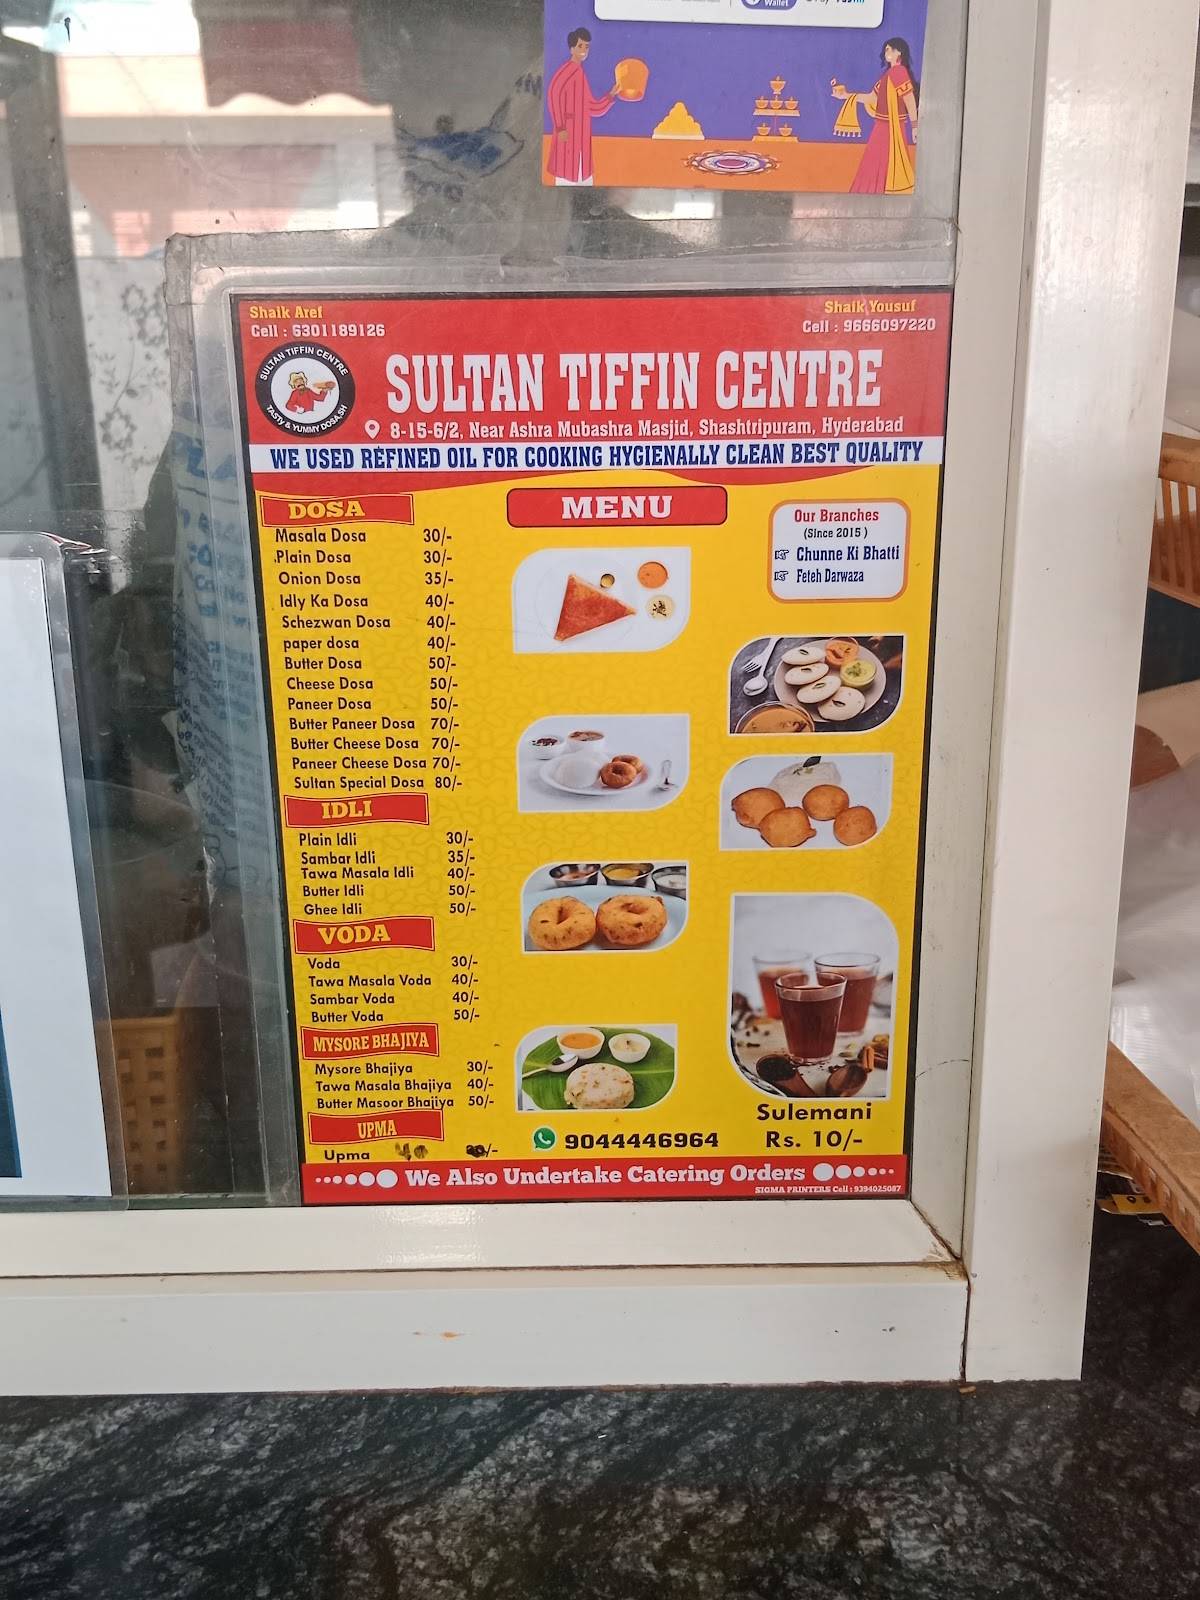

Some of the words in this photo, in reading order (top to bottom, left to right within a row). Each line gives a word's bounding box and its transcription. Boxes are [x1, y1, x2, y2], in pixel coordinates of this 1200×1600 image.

[249, 306, 291, 319] Shaik
[295, 306, 323, 319] Aref
[824, 300, 865, 314] Shaik
[869, 299, 916, 313] Yousuf
[251, 325, 278, 338] Cell
[292, 324, 385, 337] 6301189126
[802, 320, 829, 333] Cell
[843, 318, 936, 332] 9666097220
[260, 352, 286, 380] SULTAN
[285, 346, 314, 357] TIFFIN
[316, 349, 349, 376] CENTRE
[386, 353, 544, 413] SULTAN
[560, 352, 700, 411] TIFFIN
[716, 349, 883, 410] CENTRE
[292, 424, 320, 433] YUMMY
[390, 422, 464, 441] 8-15-6/2,
[469, 422, 505, 438] Near
[509, 421, 552, 438] Ashra
[558, 420, 633, 438] Mubashra
[638, 420, 694, 441] Masjid,
[699, 418, 816, 439] Shashtripuram,
[821, 416, 903, 436] Hyderabad
[271, 448, 300, 469] WE
[306, 448, 355, 469] USED
[361, 447, 441, 469] REFINED
[448, 447, 477, 468] OIL
[483, 446, 518, 468] FOR
[525, 445, 603, 467] COOKING
[609, 445, 721, 467] HYGIENALLY
[725, 443, 785, 465] CLEAN
[791, 442, 841, 464] BEST
[846, 440, 924, 463] QUALITY
[288, 500, 365, 520] DOSA
[561, 495, 672, 520] MENU
[794, 509, 816, 522] Our
[820, 508, 880, 522] Branches
[275, 528, 326, 543] Masala
[332, 527, 366, 543] Dosa
[423, 526, 452, 546] 30/-
[803, 528, 834, 540] (Since
[836, 527, 861, 538] 2015
[276, 550, 311, 564] Plain
[317, 550, 351, 563] Dosa
[423, 549, 452, 567] 30/-
[796, 546, 843, 561] Chunne
[846, 546, 859, 561] Ki
[863, 545, 900, 560] Bhatti
[278, 571, 321, 585] Onion
[326, 571, 361, 585] Dosa
[424, 571, 453, 588] 35/-
[796, 568, 822, 583] Feteh
[825, 568, 864, 582] Darwaza
[280, 594, 305, 611] Idly
[311, 594, 329, 607] Ka
[334, 594, 368, 607] Dosa
[425, 593, 454, 611] 40/-
[282, 615, 351, 628] Schezwan
[356, 615, 391, 628] Dosa
[426, 614, 456, 632] 40/-
[283, 639, 322, 652] paper
[327, 636, 359, 649] dosa
[427, 634, 456, 652] 40/-
[285, 657, 323, 670] Butter
[328, 656, 362, 669] Dosa
[428, 655, 456, 672] 50/-
[287, 677, 335, 690] Cheese
[339, 676, 374, 690] Dosa
[429, 676, 458, 693] 50/-
[287, 697, 333, 710] Paneer
[338, 697, 372, 710] Dosa
[430, 696, 458, 713] 50/-
[289, 717, 327, 730] Butter
[332, 717, 377, 730] Paneer
[381, 717, 415, 729] Dosa
[431, 716, 459, 733] 70/-
[290, 737, 328, 750] Butter
[333, 737, 381, 749] Cheese
[385, 736, 419, 749] Dosa
[431, 736, 460, 753] 70/-
[292, 757, 337, 769] Paneer
[341, 756, 389, 769] Cheese
[393, 756, 427, 769] Dosa
[432, 755, 461, 772] 70/-
[294, 776, 335, 789] Sultan
[340, 776, 386, 791] Special
[391, 775, 424, 788] Dosa
[434, 775, 462, 792] 80/-
[321, 800, 373, 819] IDLI
[299, 833, 331, 846] Plain
[337, 832, 357, 845] Idli
[446, 830, 473, 848] 30/-
[301, 851, 350, 865] Sambar
[355, 851, 376, 864] Idli
[447, 849, 475, 866] 35/-
[301, 867, 337, 879] Tawa
[342, 866, 389, 879] Masala
[394, 866, 414, 878] Idli
[447, 866, 475, 882] 40/-
[303, 885, 339, 897] Butter
[344, 884, 364, 896] Idli
[448, 883, 476, 899] 50/-
[304, 904, 337, 915] Ghee
[342, 903, 362, 914] Idli
[449, 901, 476, 917] 50/-
[318, 924, 391, 945] VODA
[308, 957, 340, 969] Voda
[451, 955, 478, 970] 30/-
[308, 975, 344, 987] Tawa
[348, 975, 395, 986] Masala
[400, 974, 431, 986] Voda
[451, 972, 479, 988] 40/-
[310, 993, 358, 1005] Sambar
[363, 992, 395, 1004] Voda
[452, 990, 479, 1005] 40/-
[311, 1011, 347, 1023] Butter
[352, 1010, 384, 1022] Voda
[453, 1008, 480, 1023] 50/-
[313, 1035, 370, 1052] MYSORE
[372, 1031, 429, 1049] BHAJIYA
[315, 1063, 361, 1078] Mysore
[366, 1062, 413, 1077] Bhajiya
[466, 1060, 493, 1075] 30/-
[315, 1081, 350, 1092] Tawa
[355, 1080, 400, 1091] Masala
[405, 1079, 452, 1094] Bhajiya
[467, 1077, 494, 1092] 40/-
[317, 1098, 352, 1109] Butter
[357, 1097, 403, 1108] Masoor
[407, 1096, 454, 1110] Bhajiya
[468, 1095, 494, 1110] 50/-
[756, 1102, 872, 1121] Sulemani
[357, 1119, 397, 1140] UPMA
[565, 1132, 718, 1149] 9044446964
[766, 1131, 801, 1148] Rs.
[813, 1129, 862, 1151] 10/-
[324, 1149, 370, 1163] Upma
[405, 1169, 440, 1186] We
[446, 1168, 498, 1185] Also
[503, 1165, 622, 1185] Undertake
[627, 1165, 725, 1185] Catering
[730, 1163, 805, 1183] Orders
[755, 1186, 785, 1194] SIGMA
[832, 1185, 848, 1193] Cell
